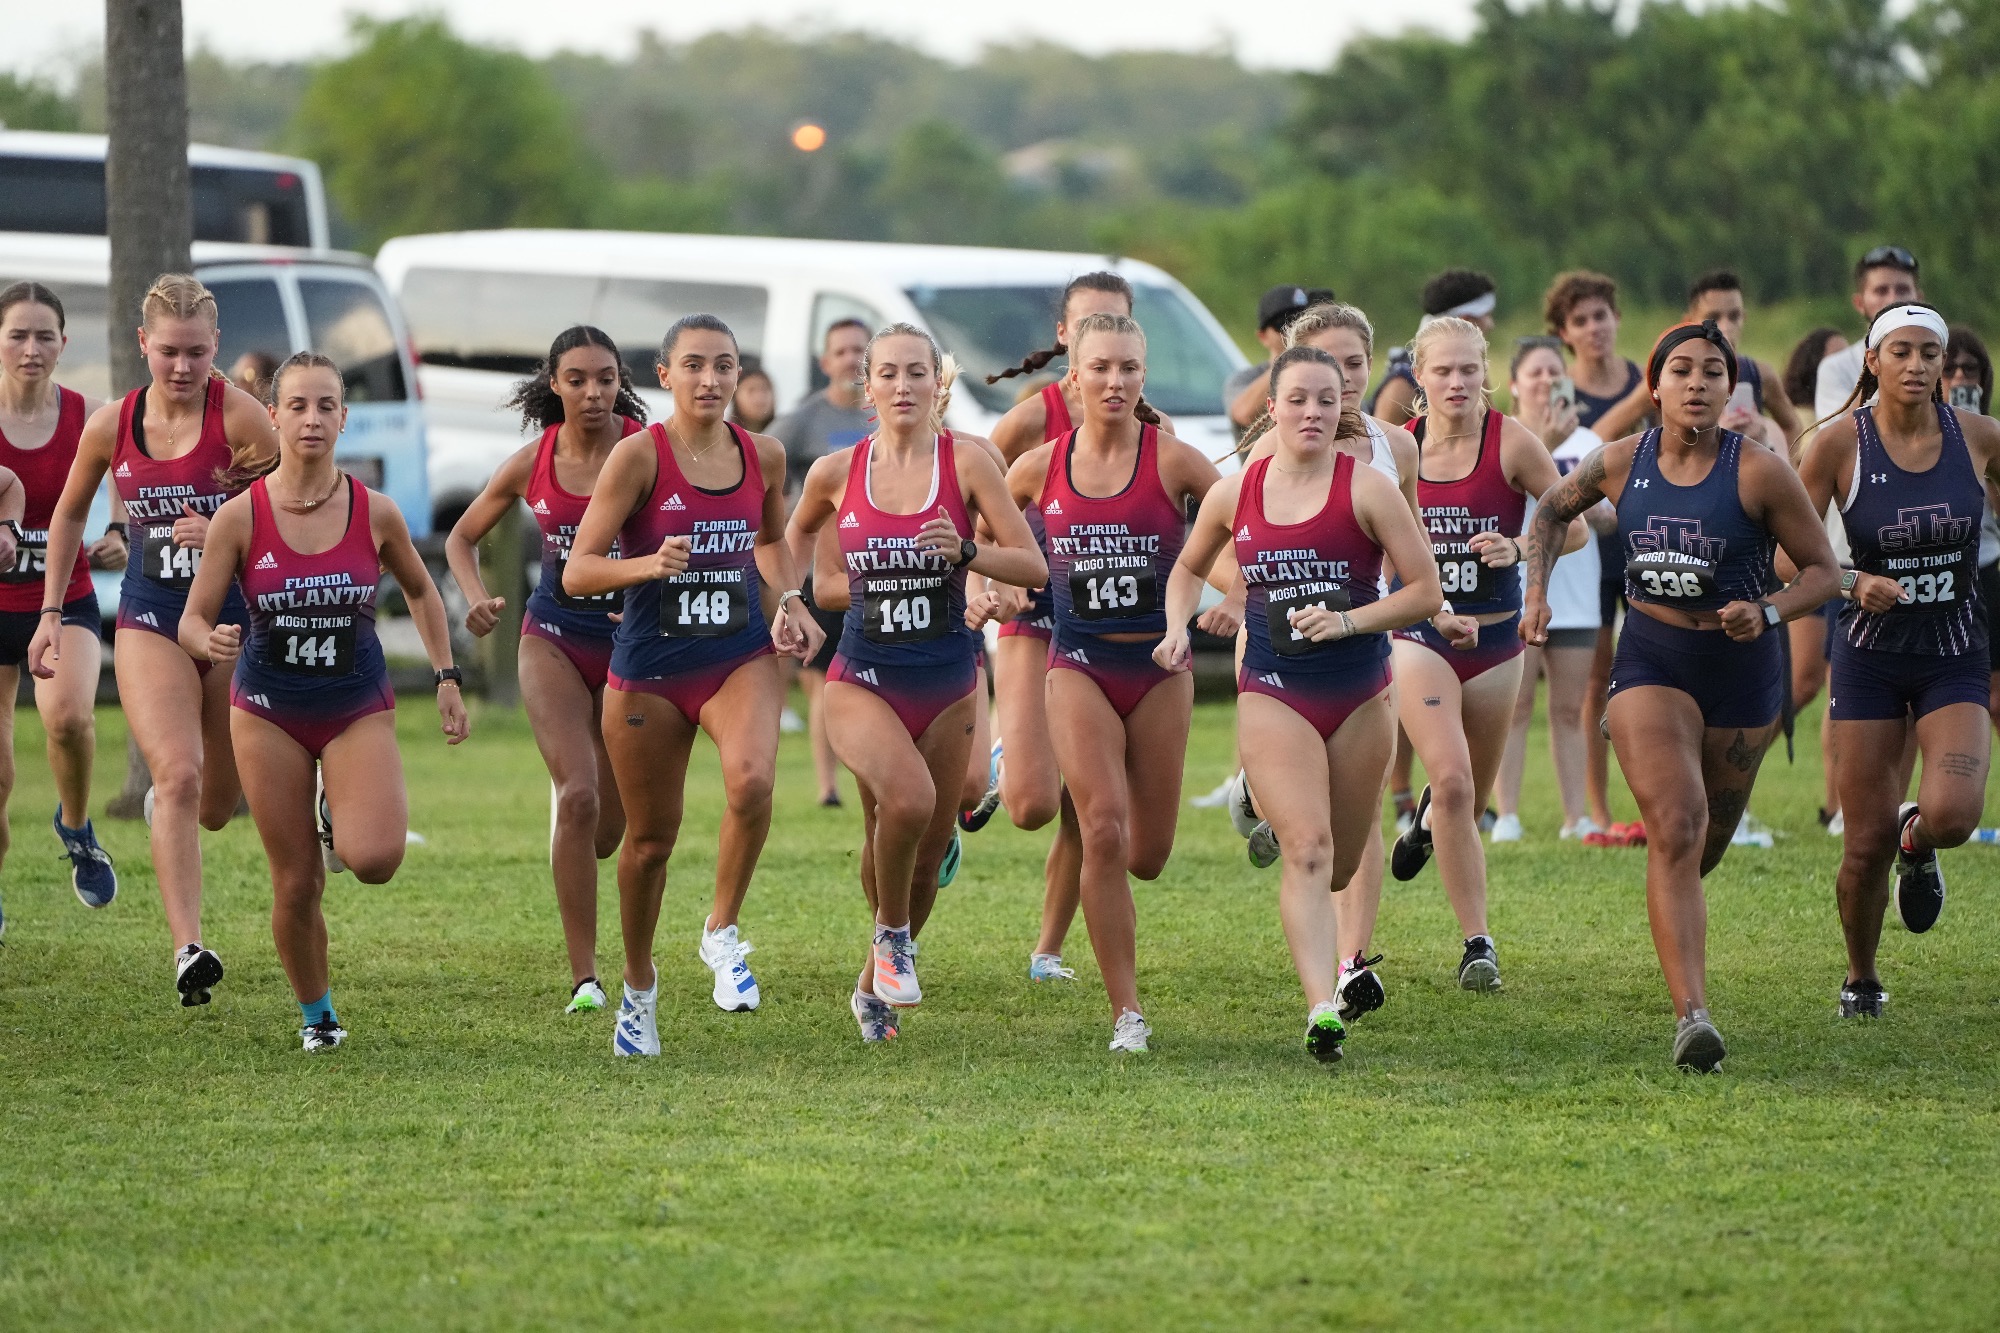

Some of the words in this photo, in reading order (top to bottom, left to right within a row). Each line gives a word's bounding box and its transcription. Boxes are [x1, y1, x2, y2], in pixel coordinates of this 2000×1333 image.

[139, 484, 196, 499] FLORIDA
[660, 503, 686, 511] adidas
[1420, 506, 1471, 518] LORIDA
[149, 526, 174, 539] MOG
[692, 519, 747, 533] FLORIDA
[1069, 523, 1130, 536] FLORIDA
[1426, 515, 1499, 535] ANTIC
[22, 530, 49, 542] IMIN
[1051, 535, 1160, 555] ATLANTIC
[1074, 558, 1105, 572] MOGO
[1107, 555, 1148, 569] TIMING
[1257, 548, 1319, 563] FLORIDA
[1634, 551, 1666, 563] MOGO
[1668, 551, 1710, 567] TIMING
[1888, 556, 1920, 570] MOGO
[1922, 550, 1962, 567] TIMING
[254, 562, 278, 570] adidas
[1241, 560, 1351, 584] ATLANTIC
[284, 572, 352, 590] FLORIDA
[702, 570, 742, 583] TIMING
[867, 580, 899, 593] MOGO
[901, 577, 943, 591] TIMING
[1436, 560, 1478, 593] 38
[1641, 569, 1704, 598] 336
[1086, 575, 1139, 610] 143
[1268, 588, 1298, 603] MOGO
[1298, 581, 1342, 597] TIMING
[1896, 570, 1956, 605] 332
[257, 584, 375, 612] ATLANTIC
[678, 590, 731, 625] 148
[879, 595, 931, 633] 140
[275, 615, 308, 629] MOGO
[310, 615, 352, 629] TIMING
[284, 635, 337, 667] 144
